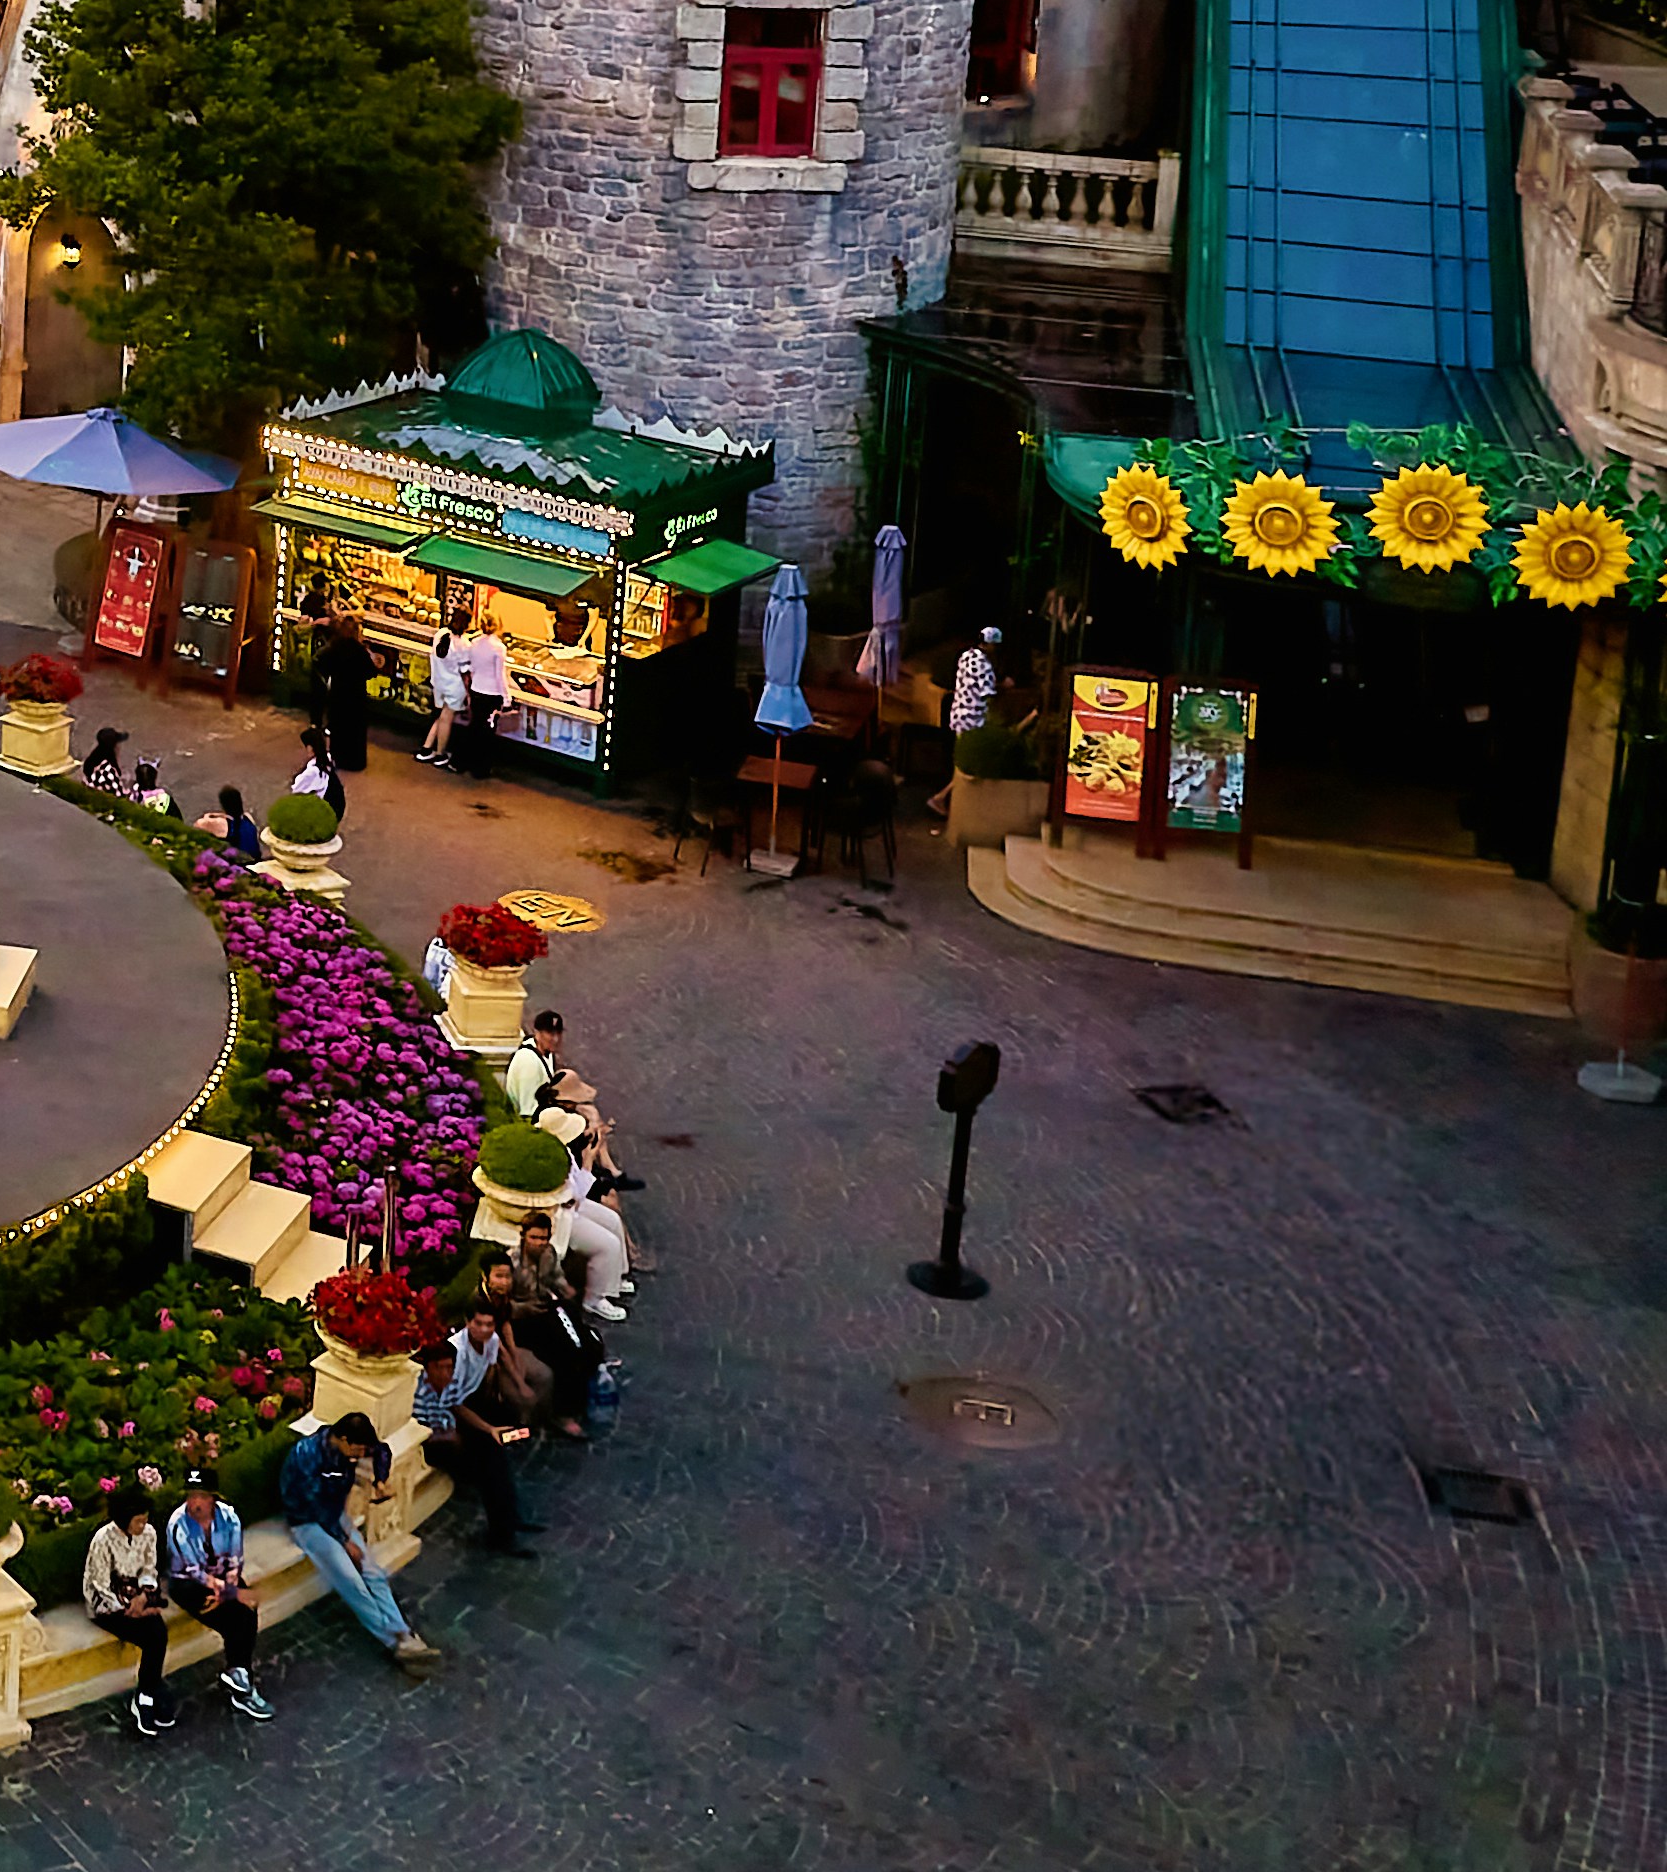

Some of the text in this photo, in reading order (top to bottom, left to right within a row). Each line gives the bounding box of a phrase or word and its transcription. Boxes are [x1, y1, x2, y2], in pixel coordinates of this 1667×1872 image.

[305, 446, 355, 464] COFFEE
[371, 461, 415, 479] FRESH
[420, 472, 461, 490] FRUIT
[467, 483, 508, 502] JUICE
[438, 495, 495, 523] Fresco
